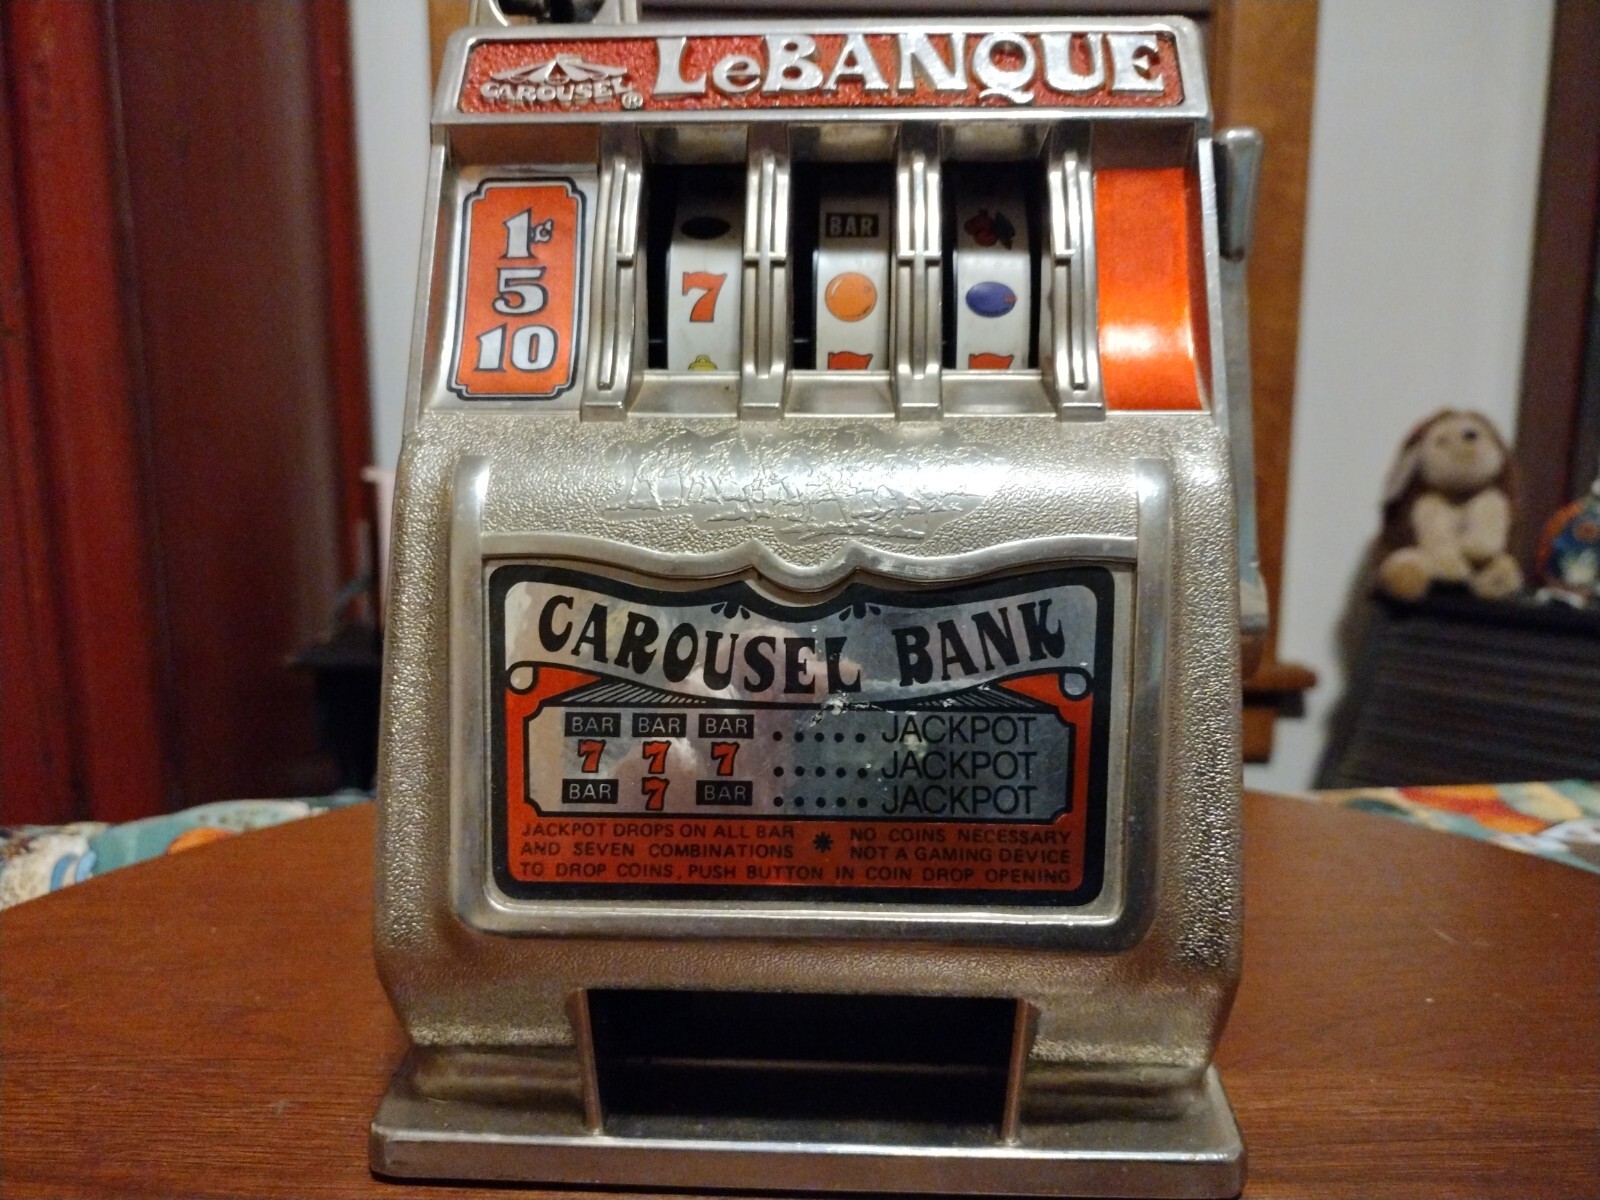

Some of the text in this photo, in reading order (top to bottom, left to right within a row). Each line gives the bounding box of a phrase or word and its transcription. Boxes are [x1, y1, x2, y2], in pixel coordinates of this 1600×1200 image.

[652, 33, 1165, 104] LeBANQUE
[480, 77, 633, 103] CAROUSEL
[829, 214, 874, 237] BAR
[492, 266, 548, 317] 5
[682, 271, 728, 323] 7
[474, 323, 558, 373] 10
[538, 594, 1065, 694] CAROUSEL BANK
[571, 715, 1037, 745] BAR BAR BAR JACKPOT
[577, 739, 1038, 781] 7 7 7 JACKPOT
[569, 776, 1038, 815] BAR 7 BAR JACKPOT
[522, 822, 795, 839] JACKPOT DROPS ON ALL BAR
[850, 827, 1071, 845] NO COINS NECESSARY
[520, 842, 794, 859] AND SEVEN COMBINATIONS
[850, 847, 1071, 865] NOT A GAMING DEVICE
[520, 862, 544, 877] TO
[556, 862, 607, 877] DROP
[688, 864, 736, 879] PUSH
[746, 865, 823, 880] BUTTON
[836, 866, 854, 880] IN
[865, 866, 912, 881] COIN
[922, 867, 974, 882] DROP
[985, 868, 1071, 884] OPENING
